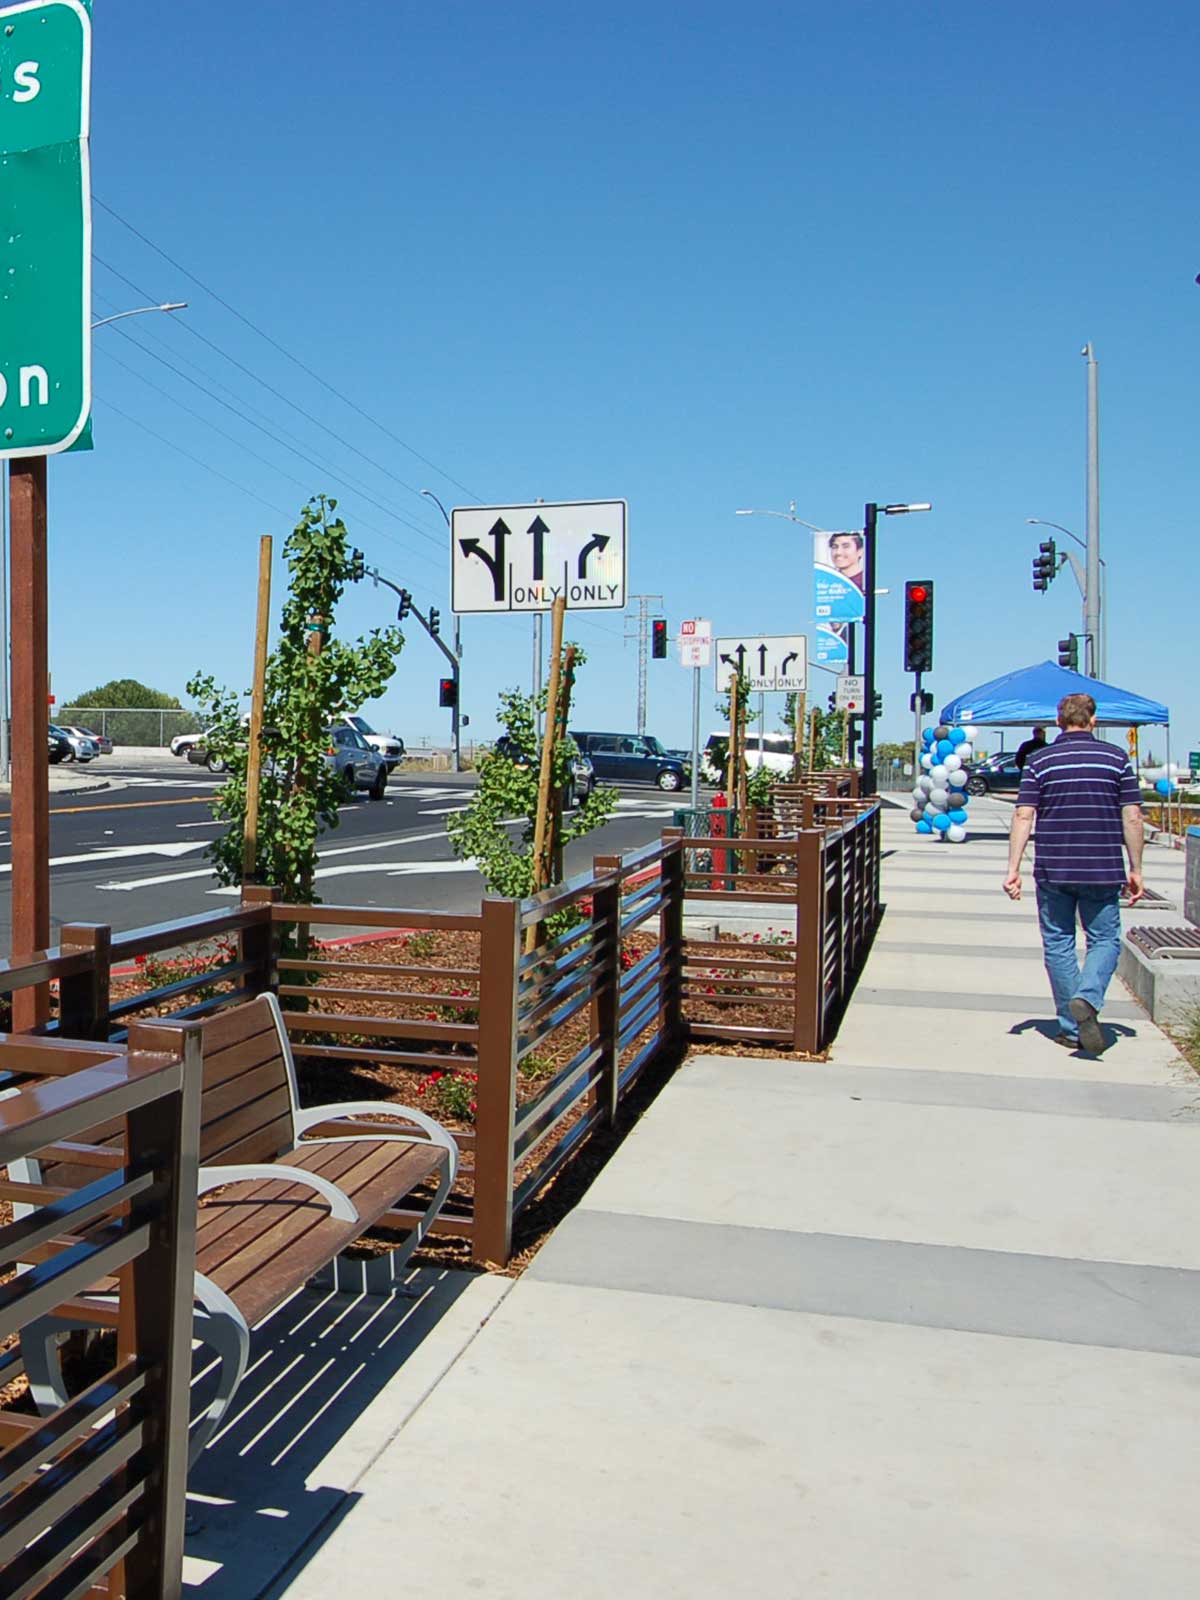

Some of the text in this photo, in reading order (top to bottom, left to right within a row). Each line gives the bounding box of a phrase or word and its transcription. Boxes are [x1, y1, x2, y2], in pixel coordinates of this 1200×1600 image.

[514, 584, 619, 603] ONLY ONLY
[682, 623, 695, 634] NO
[750, 678, 804, 688] ONLY ONLY
[844, 679, 858, 687] NO
